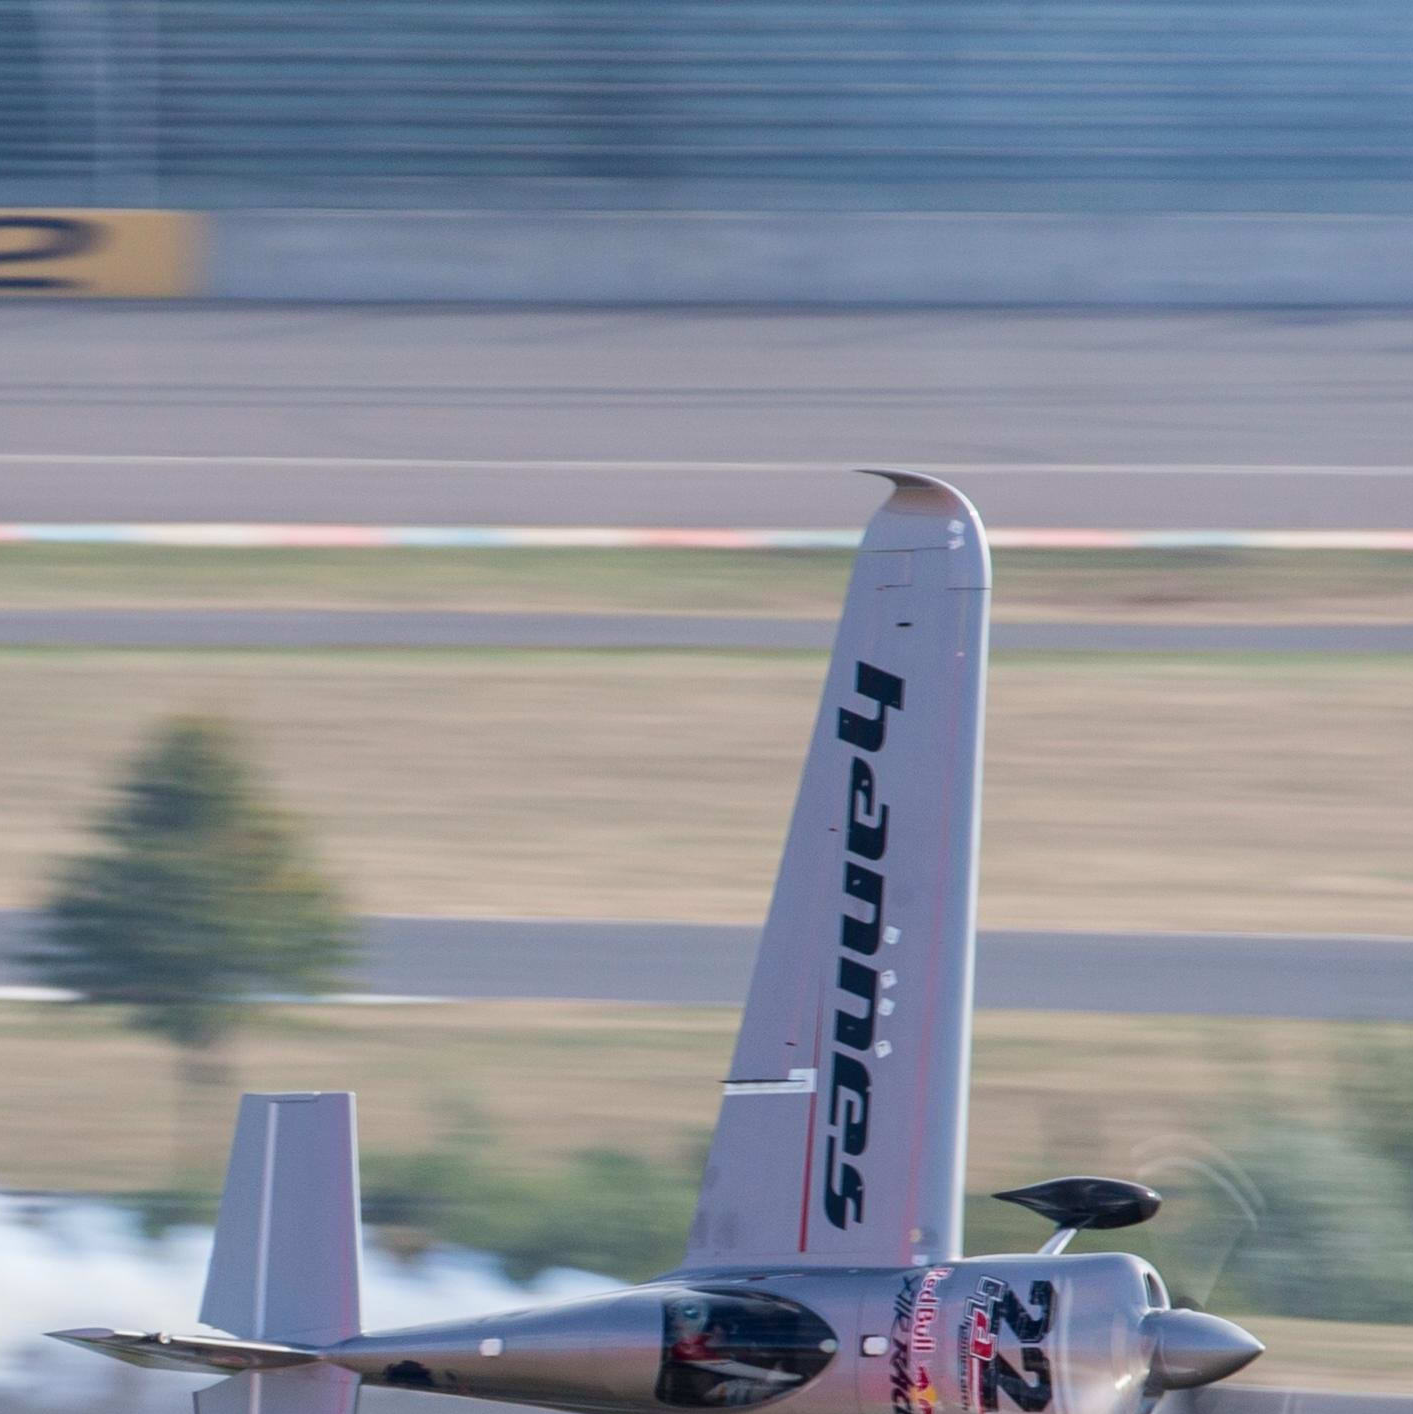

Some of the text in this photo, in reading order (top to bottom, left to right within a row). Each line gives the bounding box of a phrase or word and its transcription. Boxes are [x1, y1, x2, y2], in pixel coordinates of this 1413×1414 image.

[824, 660, 906, 1232] hannes
[913, 1267, 954, 1353] Red Bull
[984, 1280, 1057, 1412] 22
